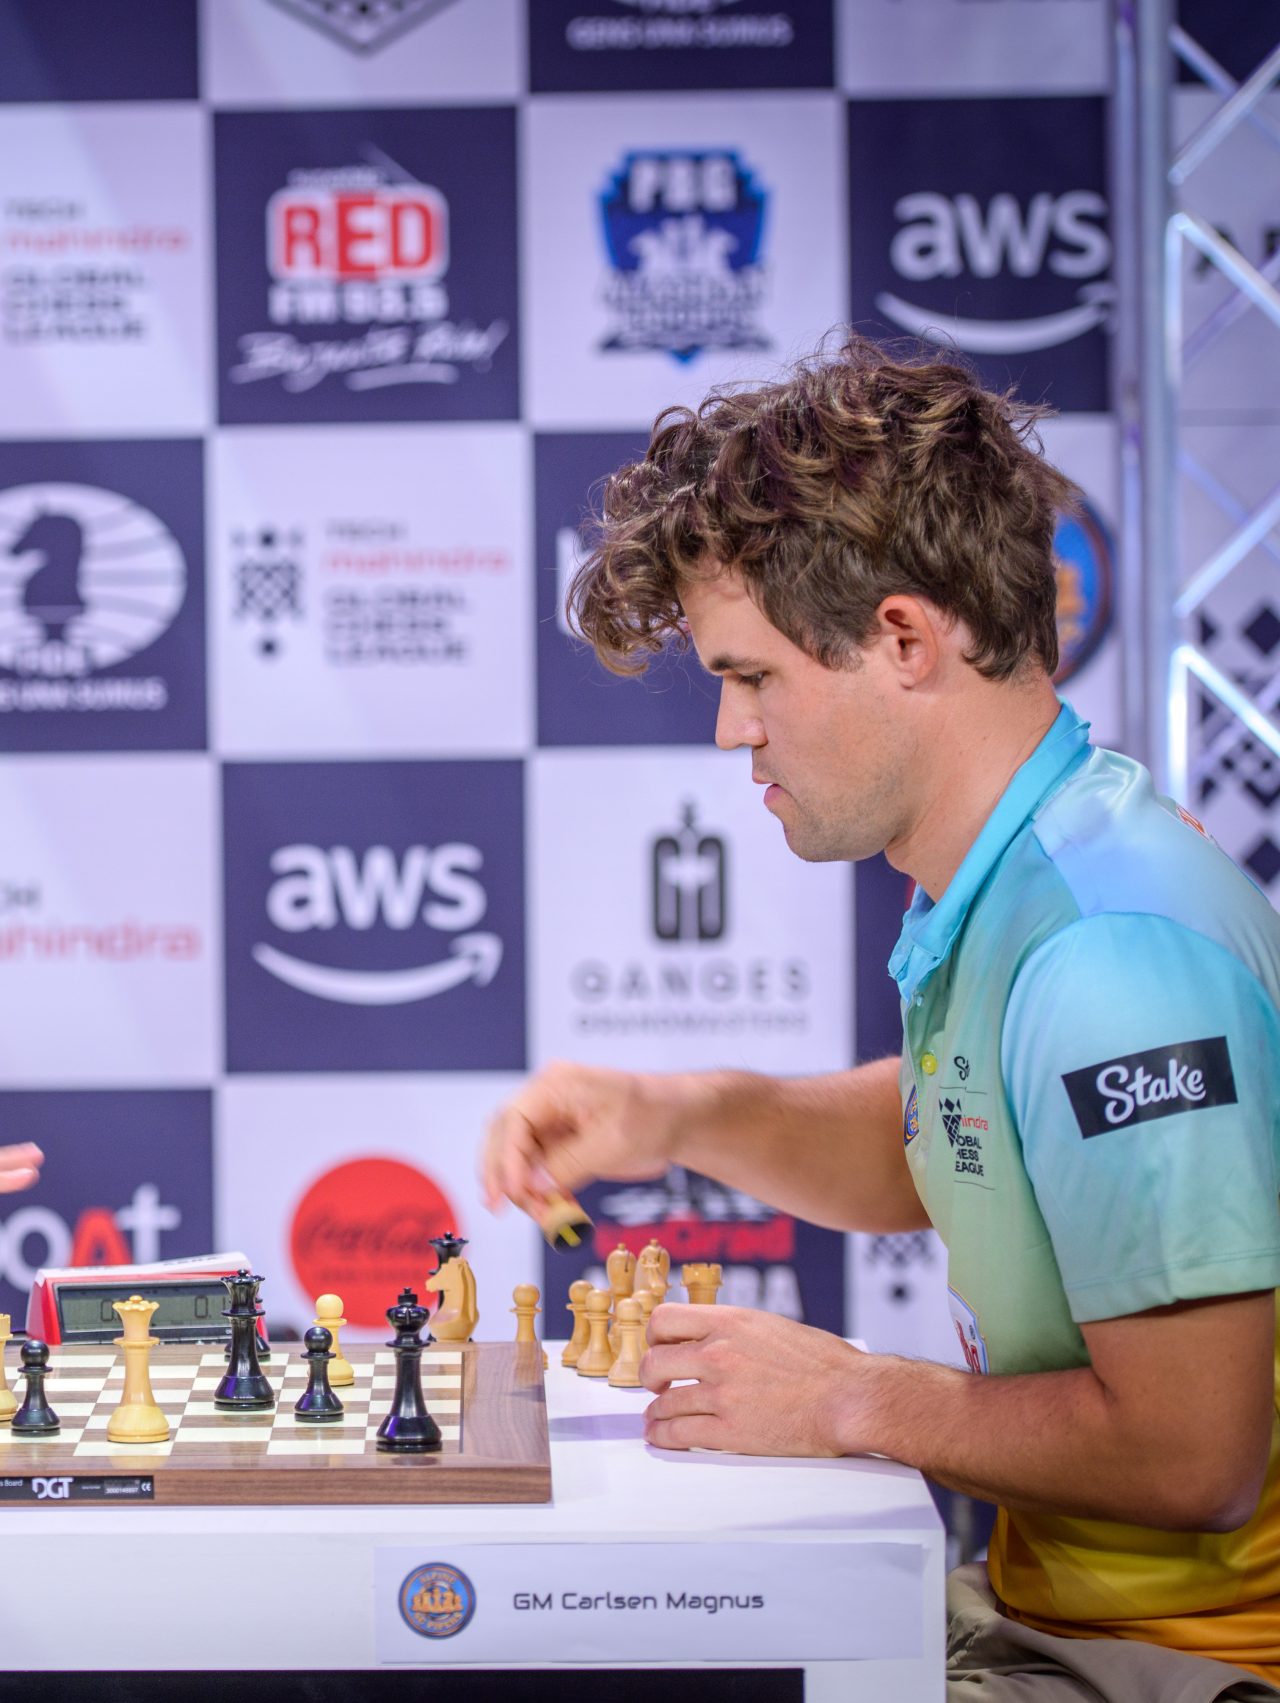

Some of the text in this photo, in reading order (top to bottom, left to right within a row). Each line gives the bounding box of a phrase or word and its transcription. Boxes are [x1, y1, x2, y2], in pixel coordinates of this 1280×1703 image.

[283, 194, 436, 274] RED
[889, 190, 1111, 282] aws
[267, 843, 488, 932] aws
[1096, 1059, 1206, 1123] Stake
[4, 1479, 23, 1487] Board
[32, 1477, 74, 1499] DGT
[513, 1592, 765, 1614] GM Carlsen Magnus
